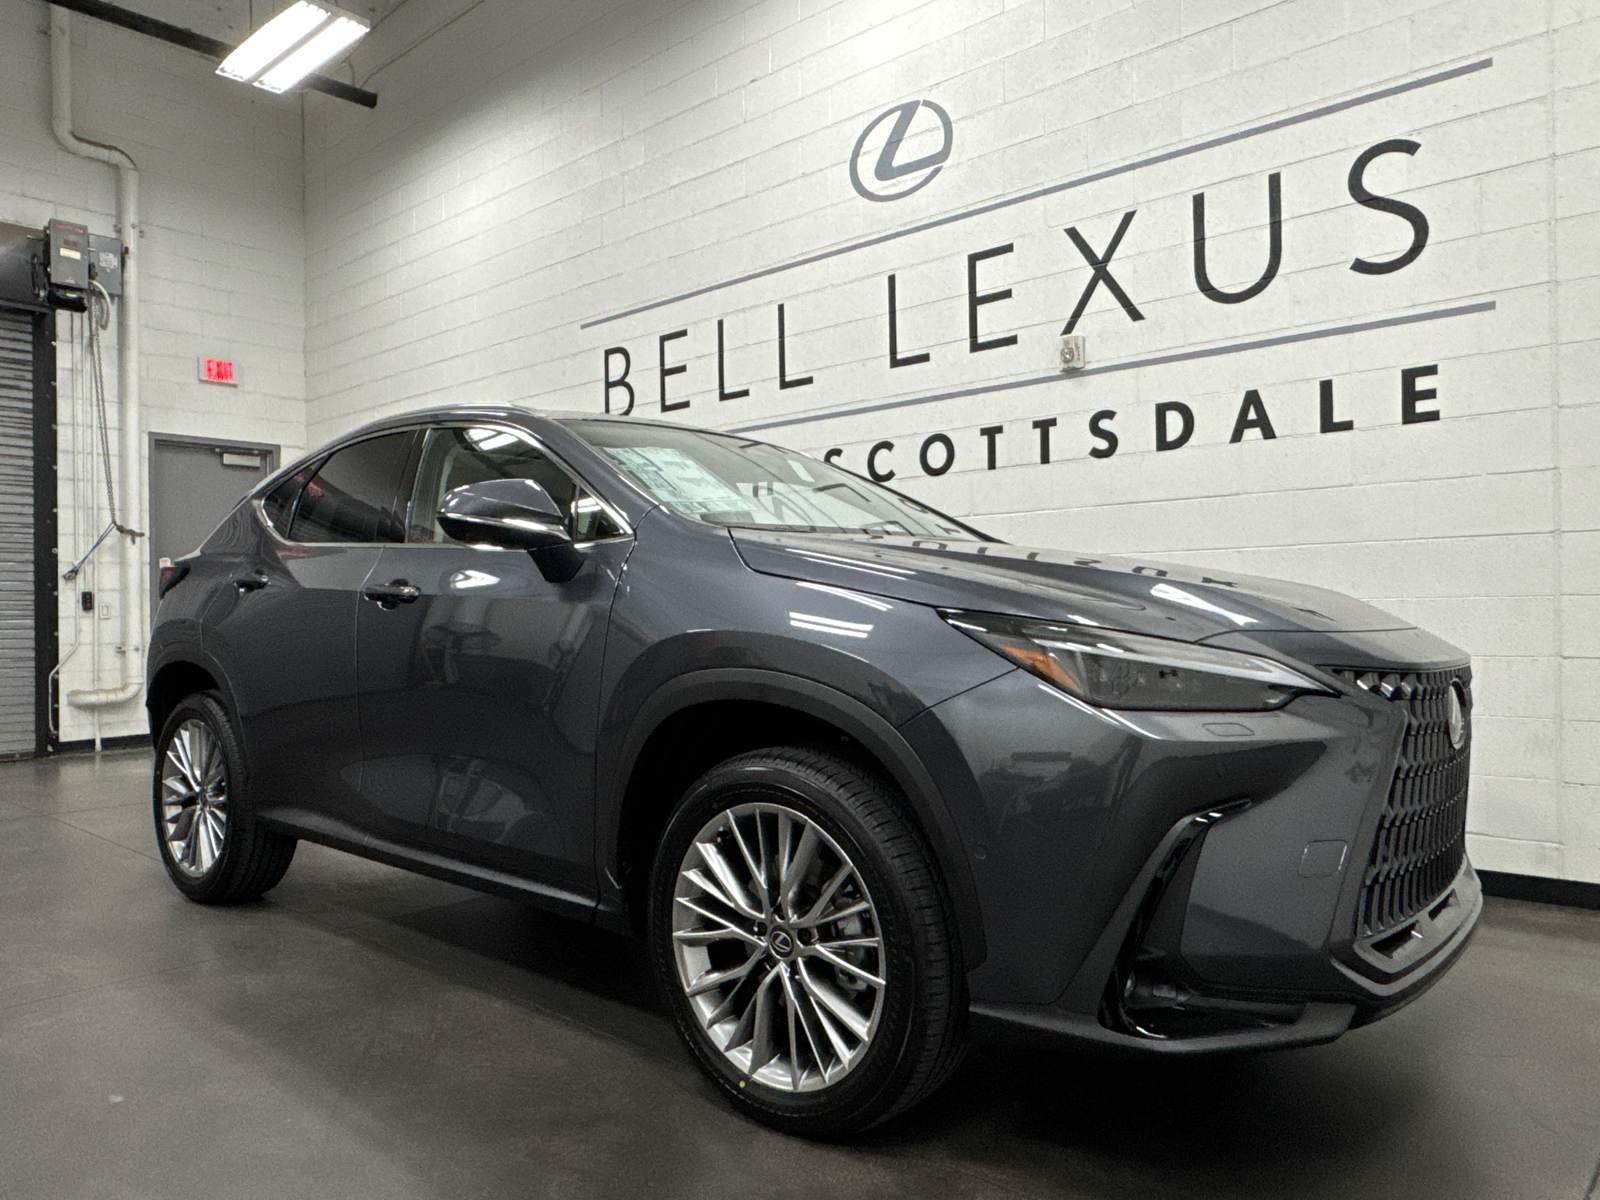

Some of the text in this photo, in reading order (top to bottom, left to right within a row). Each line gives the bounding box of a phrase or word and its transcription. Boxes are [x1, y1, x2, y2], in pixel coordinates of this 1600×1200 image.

[604, 138, 1429, 416] BELL LEXUS
[205, 358, 233, 382] EXIT
